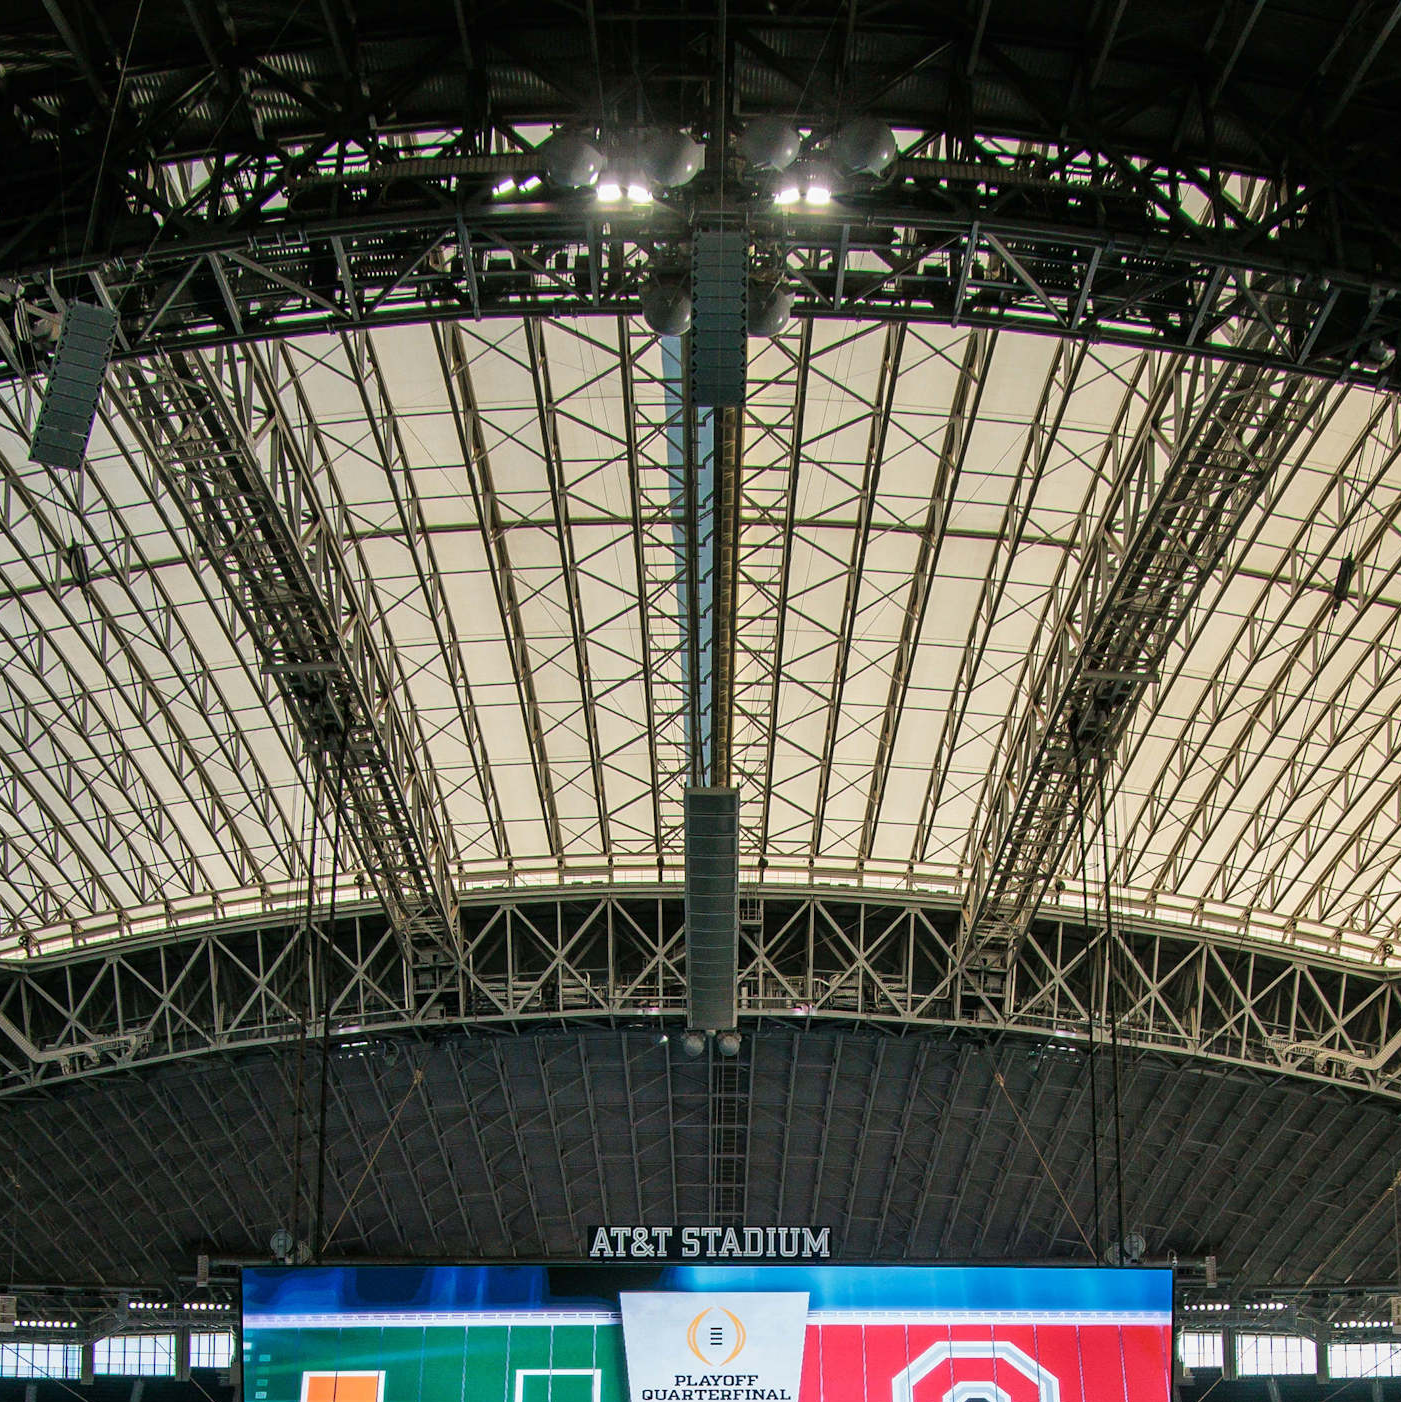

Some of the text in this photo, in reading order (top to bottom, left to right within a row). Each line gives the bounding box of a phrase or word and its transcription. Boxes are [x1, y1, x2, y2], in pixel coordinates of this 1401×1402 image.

[589, 1226, 831, 1258] AT&T STADIUM
[674, 1375, 759, 1387] PLAYOFF
[641, 1388, 791, 1401] QUARTERFINAL
